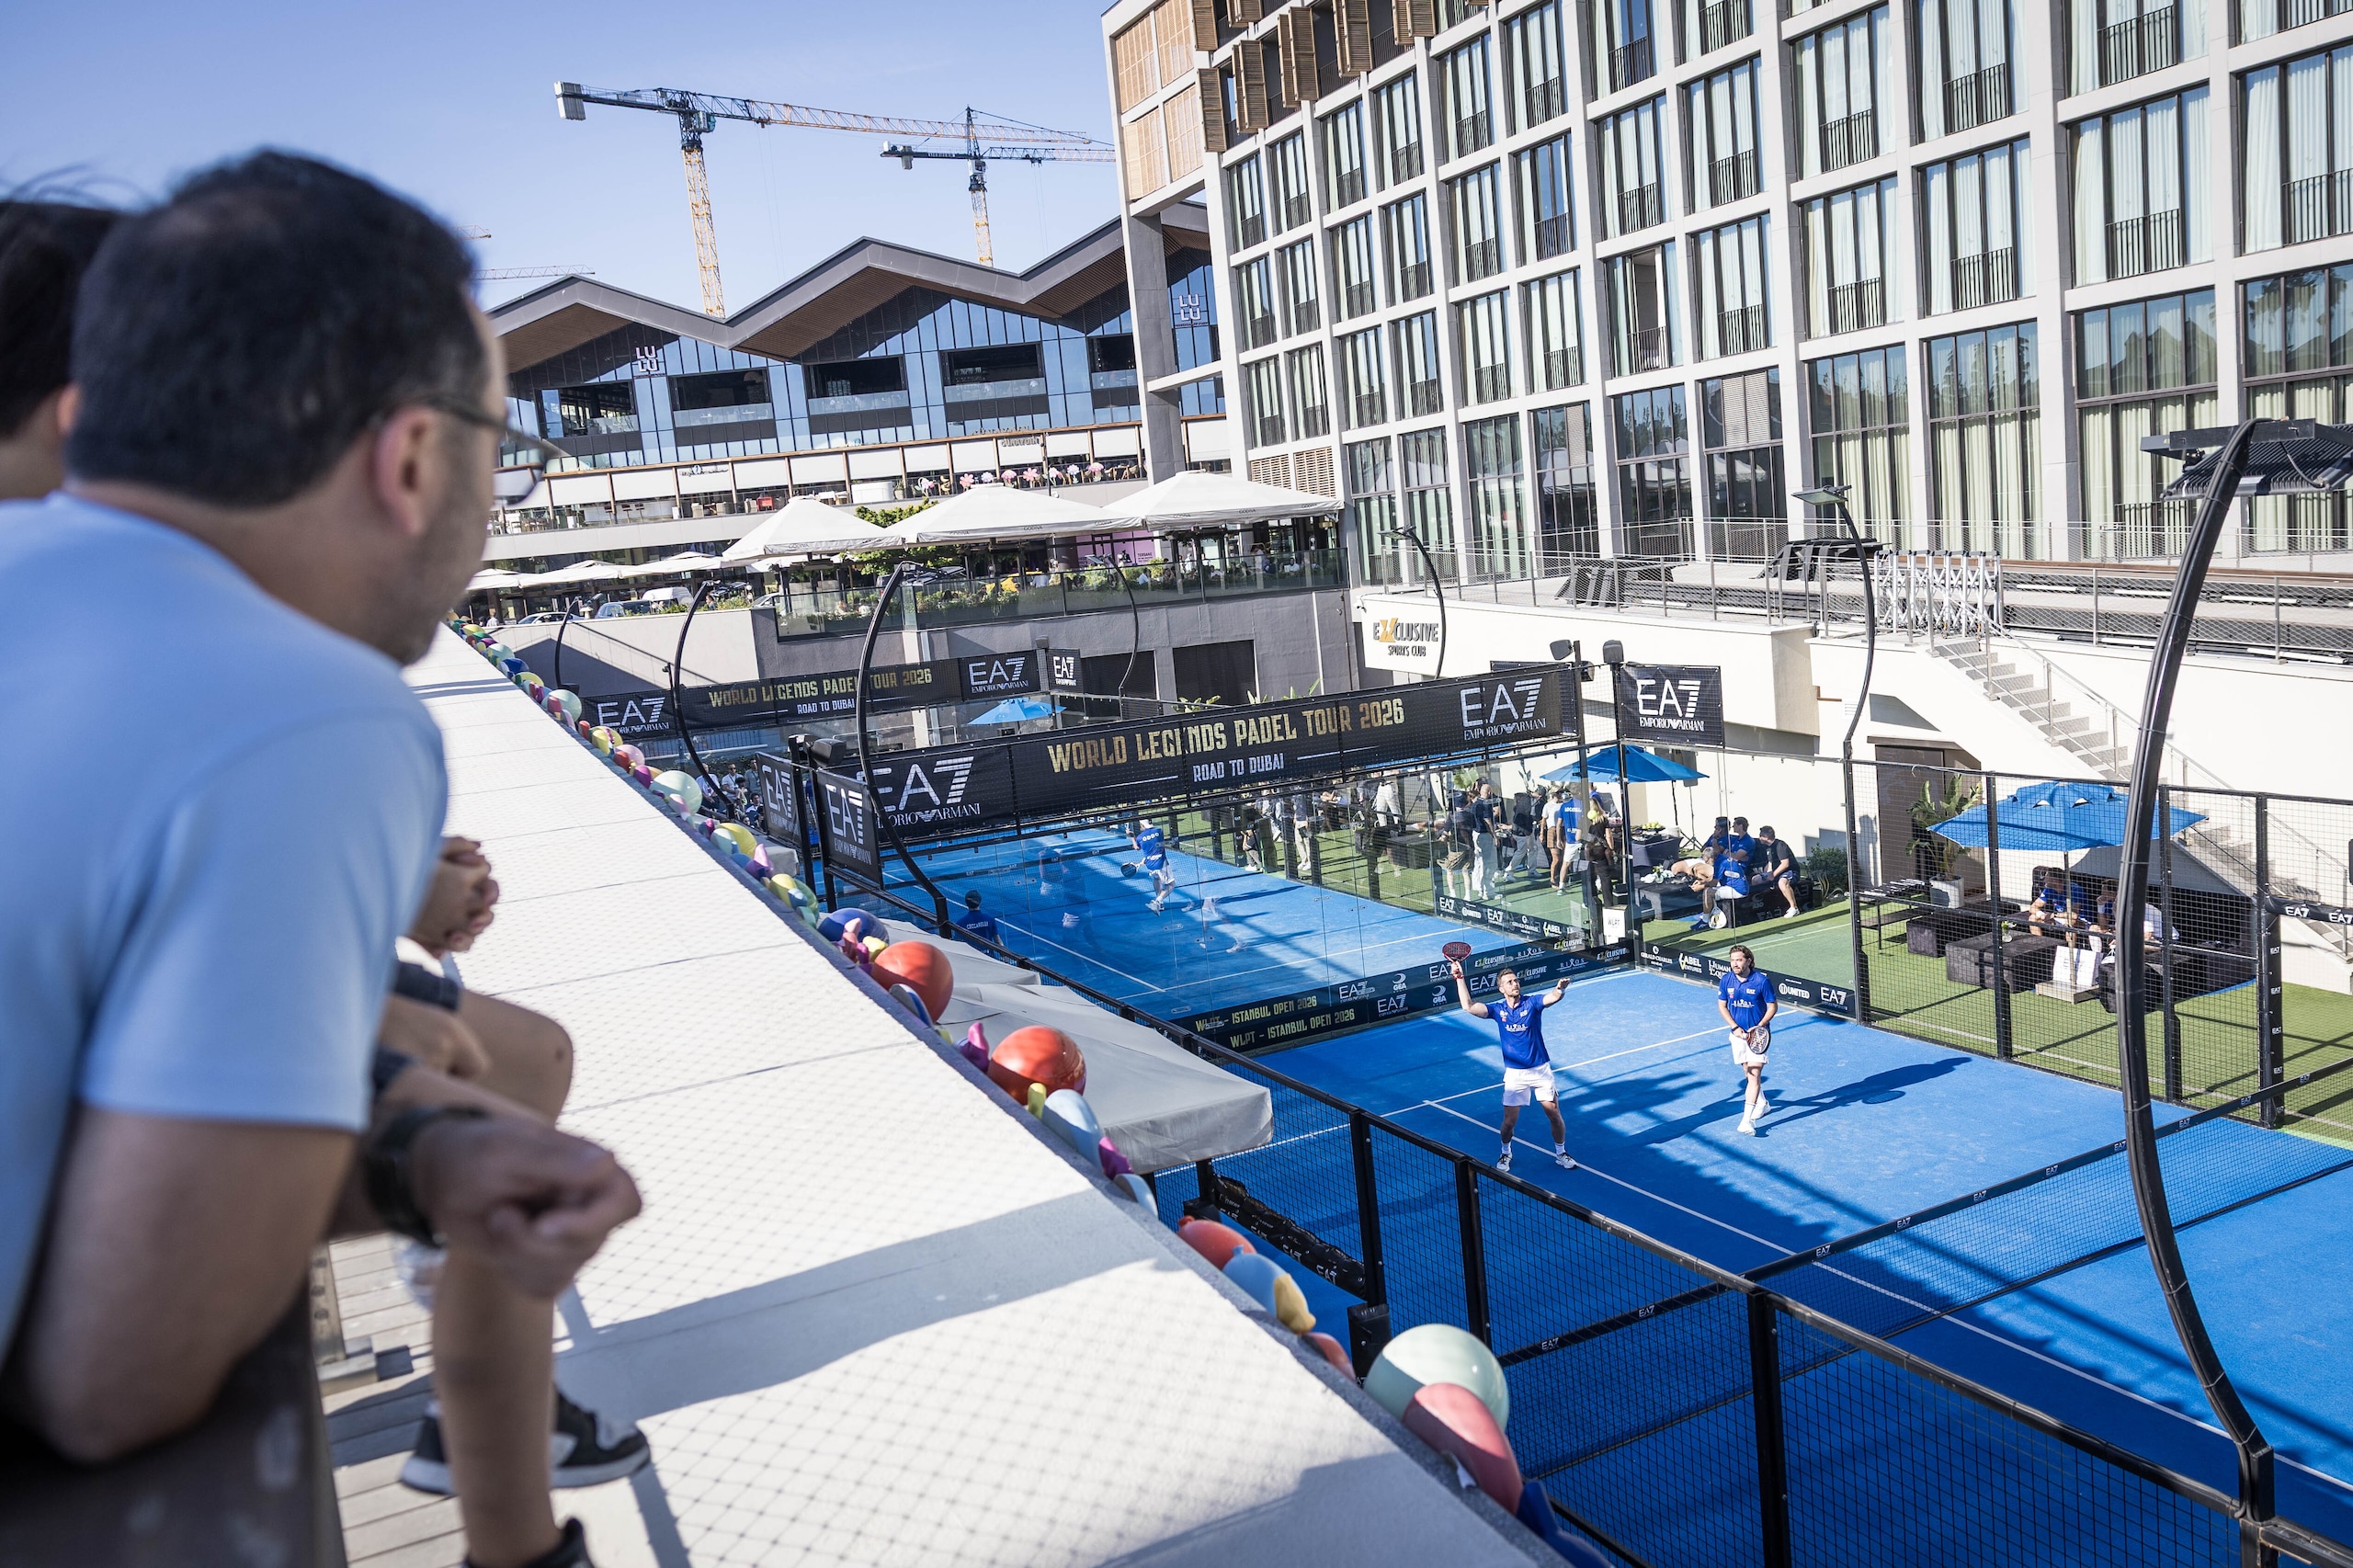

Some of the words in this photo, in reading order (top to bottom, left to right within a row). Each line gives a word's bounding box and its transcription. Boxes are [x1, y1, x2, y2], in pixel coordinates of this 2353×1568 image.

[1179, 294, 1199, 307] LU
[1180, 307, 1201, 321] LU
[635, 346, 656, 359] LU
[638, 358, 658, 372] LU
[1372, 618, 1439, 642] EXCLUSIVE
[1388, 645, 1410, 656] SPORTS
[1411, 645, 1427, 656] CLUB
[969, 657, 1025, 686] EA7
[1053, 656, 1074, 678] EA7
[709, 687, 757, 708] WORLD
[903, 667, 933, 685] 2026
[1460, 678, 1542, 728] EA7
[1636, 679, 1701, 717] EA7
[597, 696, 665, 727] EA7
[797, 702, 817, 714] ROAD
[819, 701, 829, 711] TO
[832, 698, 856, 710] DUBAI
[1463, 724, 1505, 741] EMPORIO
[1512, 718, 1546, 733] ARMANI
[1639, 717, 1671, 729] EMPORIO
[1677, 720, 1705, 732] ARMANI
[1047, 735, 1128, 773] WORLD
[1233, 712, 1298, 746] PADEL
[1301, 705, 1352, 736] TOUR
[1359, 698, 1405, 729] 2026
[1192, 760, 1226, 782] ROAD
[1231, 759, 1245, 777] TO
[1249, 752, 1285, 774] DUBAI
[761, 764, 791, 819] EA7
[825, 783, 864, 845] EA7
[933, 802, 982, 821] ARMANI
[1142, 832, 1160, 842] ODDO
[1439, 896, 1455, 909] EA7
[1487, 908, 1504, 921] EA7
[2285, 905, 2310, 918] EA7
[2328, 912, 2353, 925] EA7
[1543, 922, 1562, 935] LABEL
[1518, 947, 1543, 957] RIXOS
[1597, 948, 1626, 960] EXCLUSIVE
[2270, 946, 2280, 954] EA7
[1474, 954, 1506, 968] EXCLUSIVE
[1560, 958, 1585, 968] RIXOS
[1679, 953, 1702, 967] LABEL
[1517, 965, 1548, 979] EXCLUSIVE
[1392, 982, 1407, 991] GEA
[1470, 972, 1497, 991] EA7
[1787, 983, 1810, 999] UNITED
[1820, 987, 1847, 1006] EA7
[2270, 986, 2281, 994] EA7
[1378, 994, 1407, 1013] EA7
[1433, 995, 1447, 1004] GEA
[1232, 1006, 1271, 1025] ISTANBUL
[1273, 1000, 1295, 1016] OPEN
[1297, 995, 1317, 1010] 2026
[1230, 1030, 1256, 1049] WLPT
[1267, 1020, 1308, 1040] ISTANBUL
[1310, 1014, 1332, 1029] OPEN
[1335, 1008, 1355, 1025] 2026
[2273, 1066, 2283, 1074] EA7
[2300, 1074, 2310, 1084] EA7
[2240, 1096, 2252, 1106] EA7
[2179, 1118, 2190, 1128] EA7
[2045, 1165, 2059, 1176] EA7
[1973, 1190, 1987, 1201] EA7
[1896, 1217, 1912, 1229] EA7
[1815, 1244, 1831, 1257] EA7
[1638, 1304, 1655, 1318] EA7
[1541, 1336, 1560, 1350] EA7
